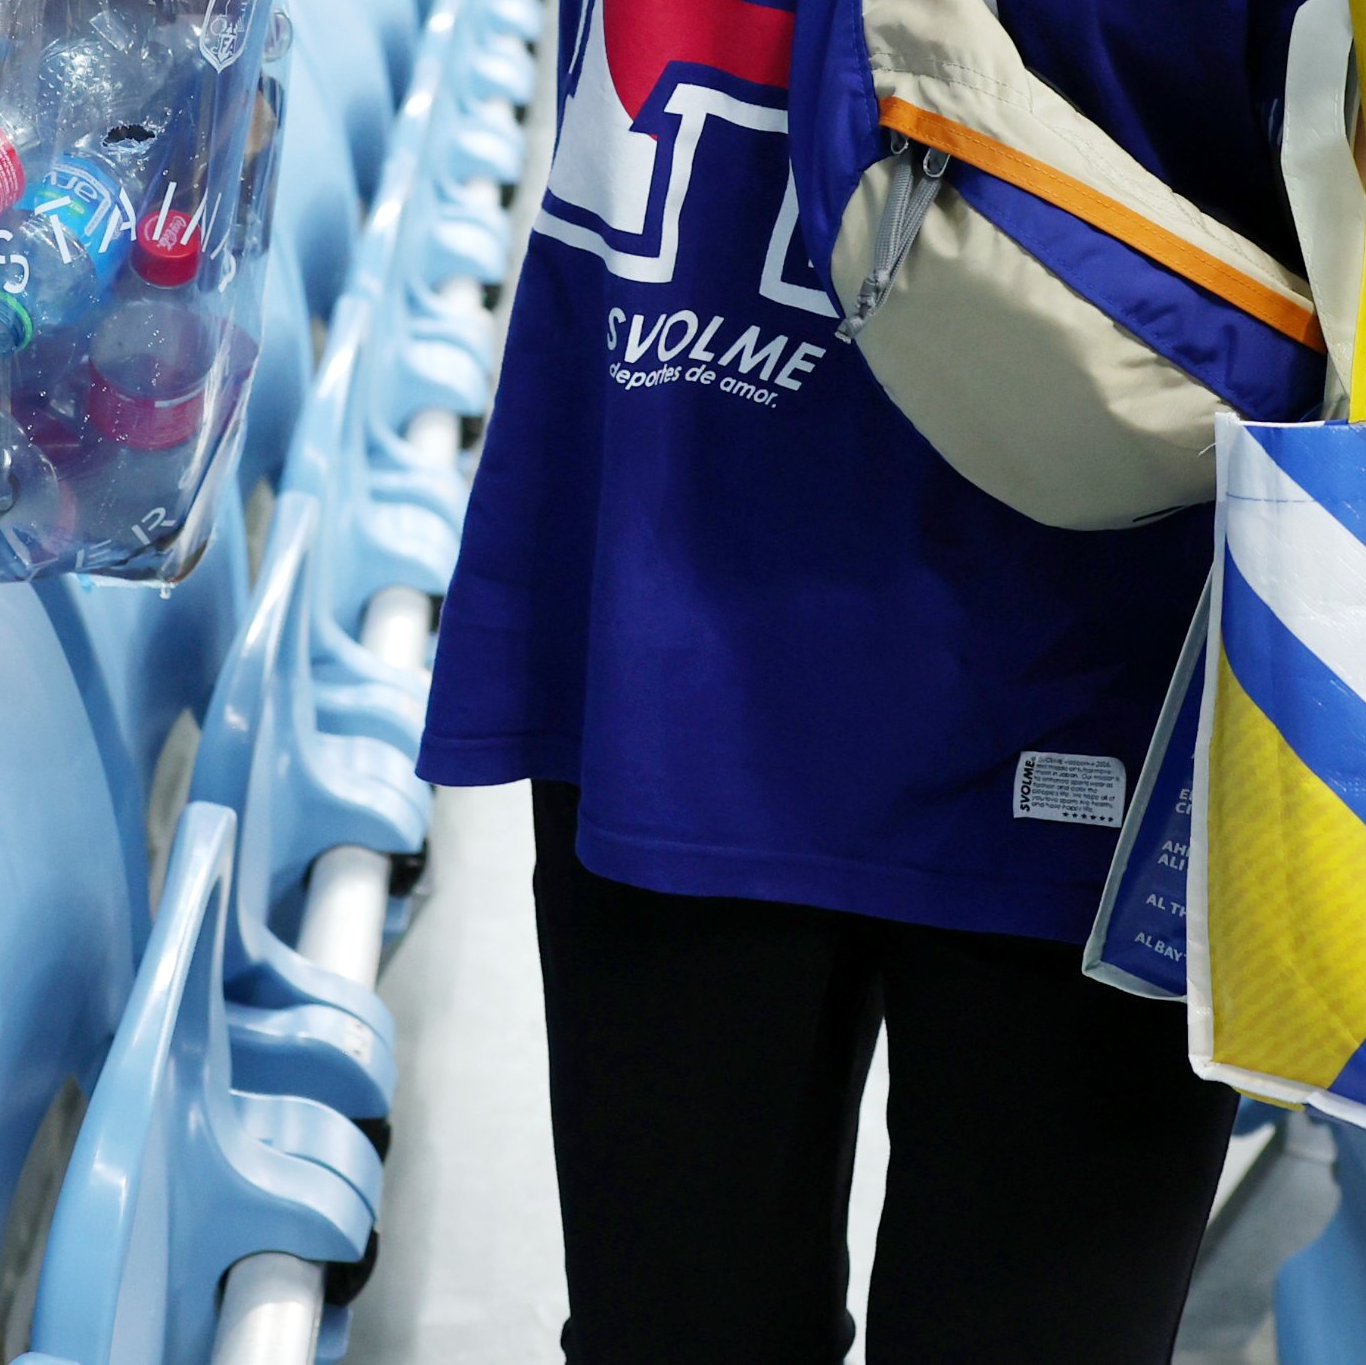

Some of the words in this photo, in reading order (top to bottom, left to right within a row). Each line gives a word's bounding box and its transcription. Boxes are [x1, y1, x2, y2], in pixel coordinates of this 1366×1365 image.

[607, 307, 827, 391] SVOLME
[609, 363, 682, 390] deportes
[685, 364, 716, 385] de
[720, 376, 778, 408] amor.
[1020, 760, 1035, 813] SVOLME
[1157, 853, 1185, 871] ALI
[1146, 893, 1166, 910] AL
[1135, 932, 1153, 948] AL
